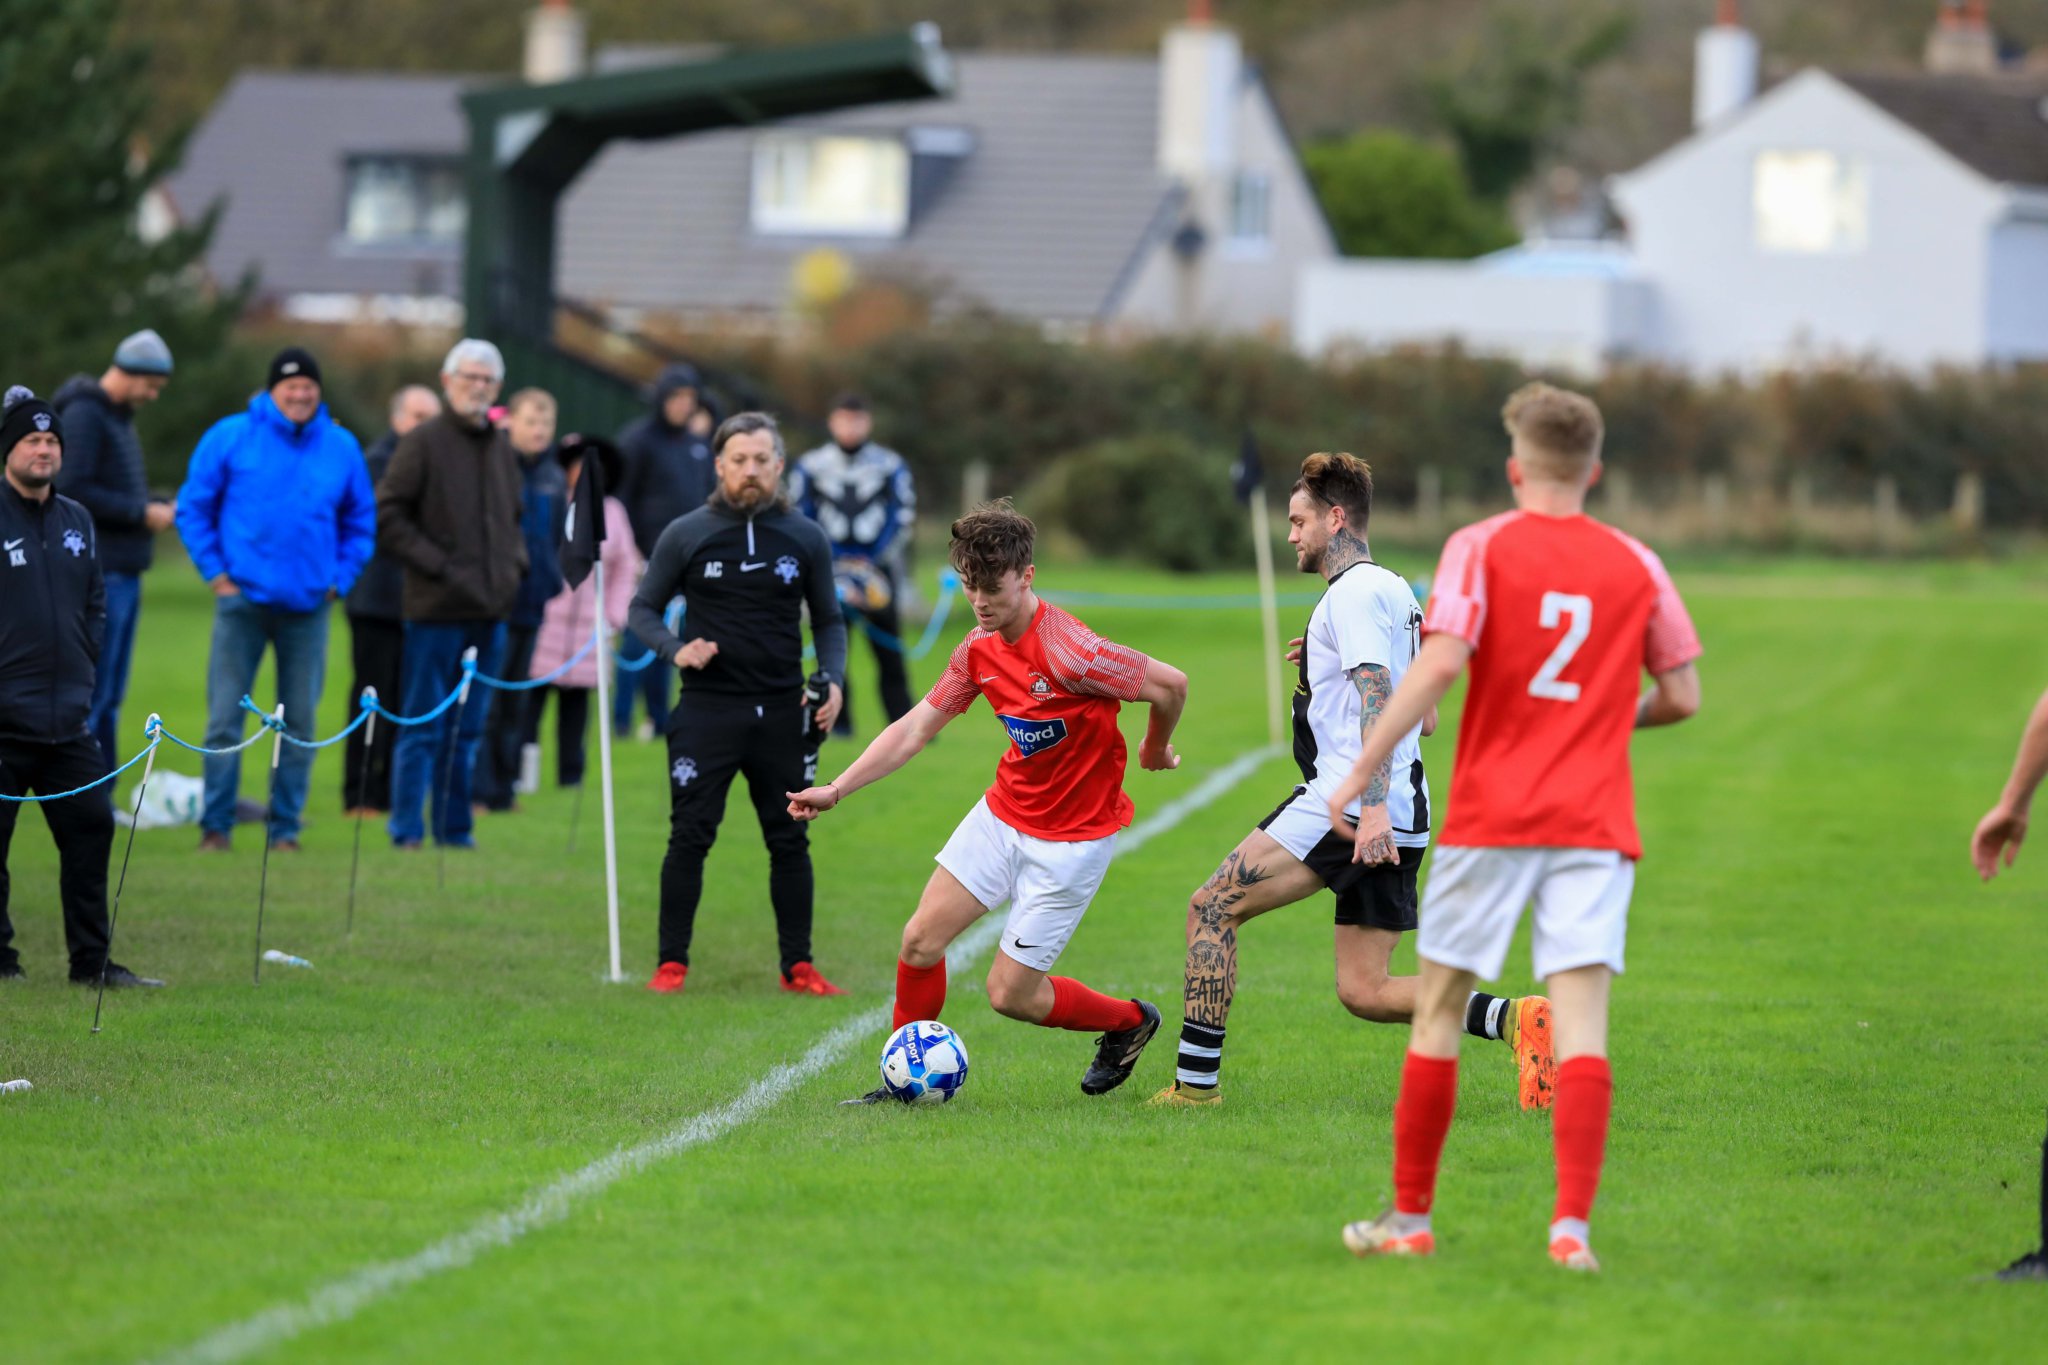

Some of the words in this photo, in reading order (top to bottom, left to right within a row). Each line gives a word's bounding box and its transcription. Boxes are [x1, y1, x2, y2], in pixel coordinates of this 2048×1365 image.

[704, 561, 723, 578] AC
[1527, 590, 1593, 702] 2
[1185, 974, 1225, 1005] EATH
